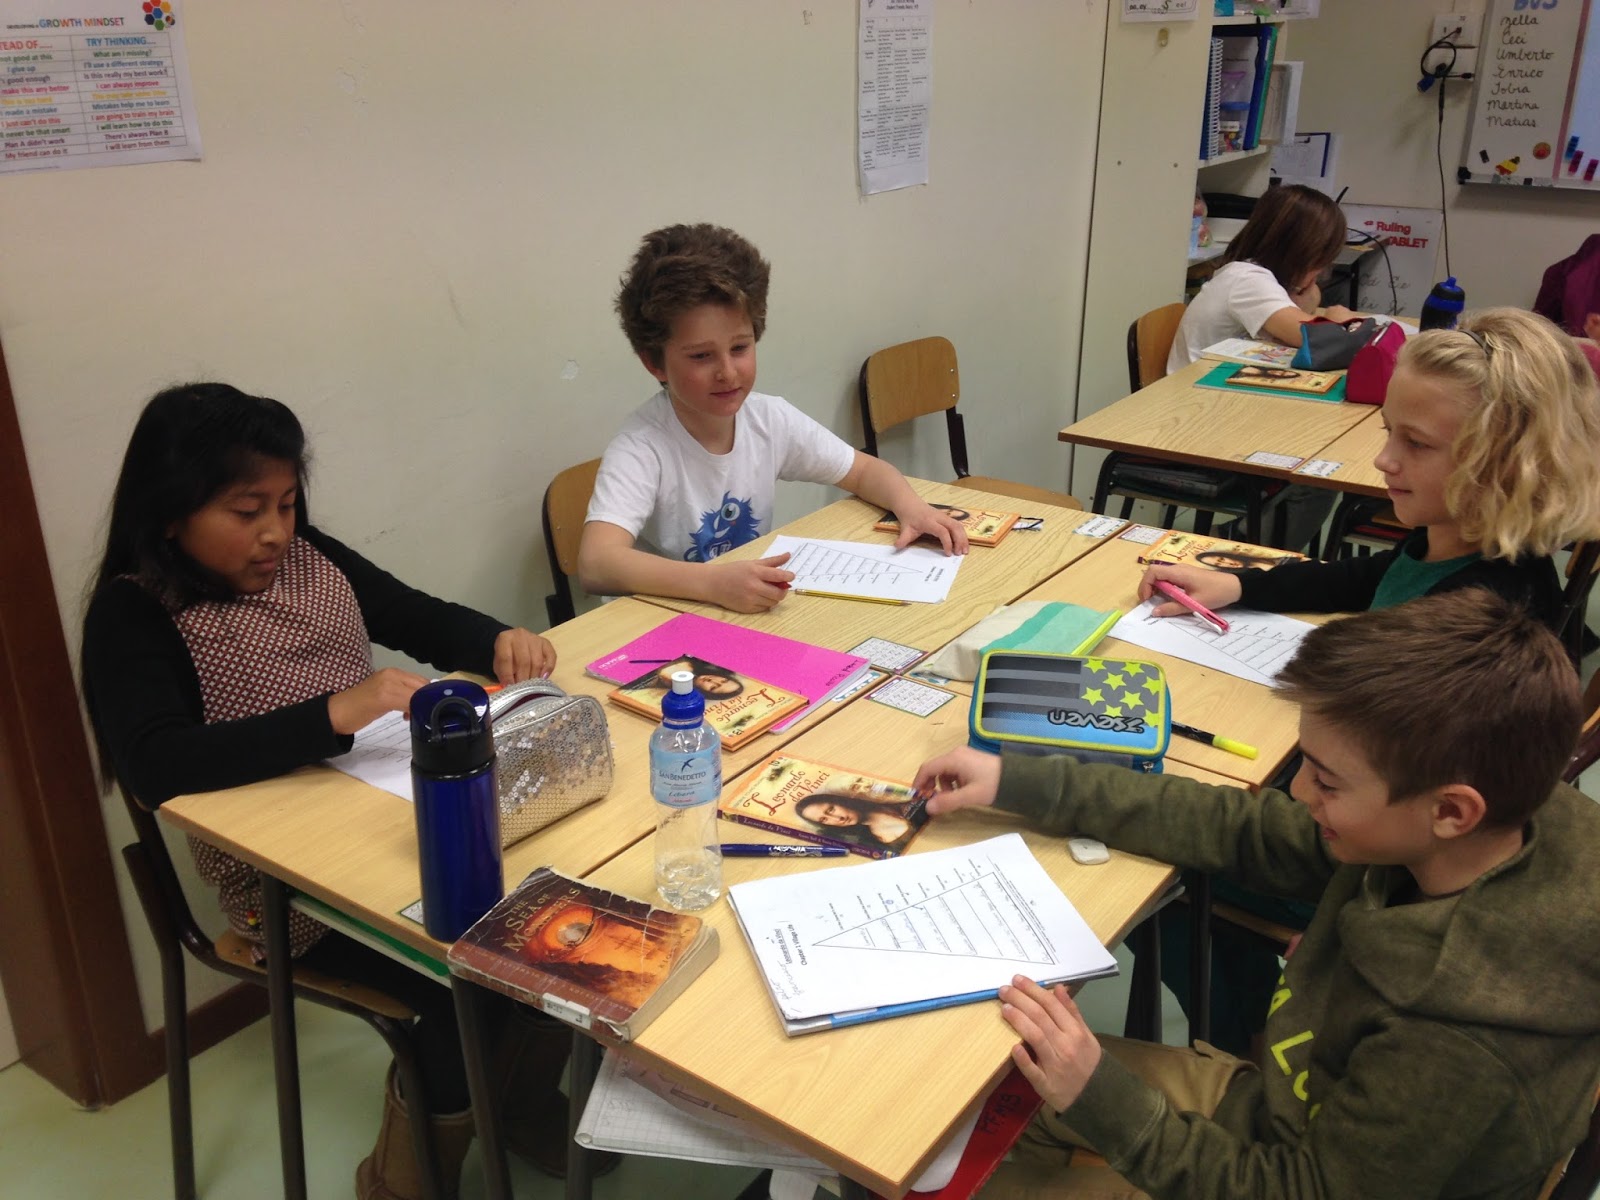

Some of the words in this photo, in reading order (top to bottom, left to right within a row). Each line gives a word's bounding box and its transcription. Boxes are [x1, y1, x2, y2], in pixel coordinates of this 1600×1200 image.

[39, 18, 82, 28] GROWTH
[84, 17, 125, 27] MINDSET
[86, 38, 103, 47] TRY
[1496, 50, 1554, 61] Umberto
[1493, 65, 1544, 79] Enrico
[1487, 100, 1539, 111] Martina
[1486, 115, 1537, 128] Matias
[1376, 221, 1412, 235] Ruling
[716, 688, 786, 723] Leonardo
[793, 770, 830, 796] Vinci
[743, 770, 806, 816] Leonardo
[505, 906, 541, 932] SEA
[537, 893, 550, 904] OF
[511, 900, 528, 914] THE
[797, 949, 808, 966] Chapter
